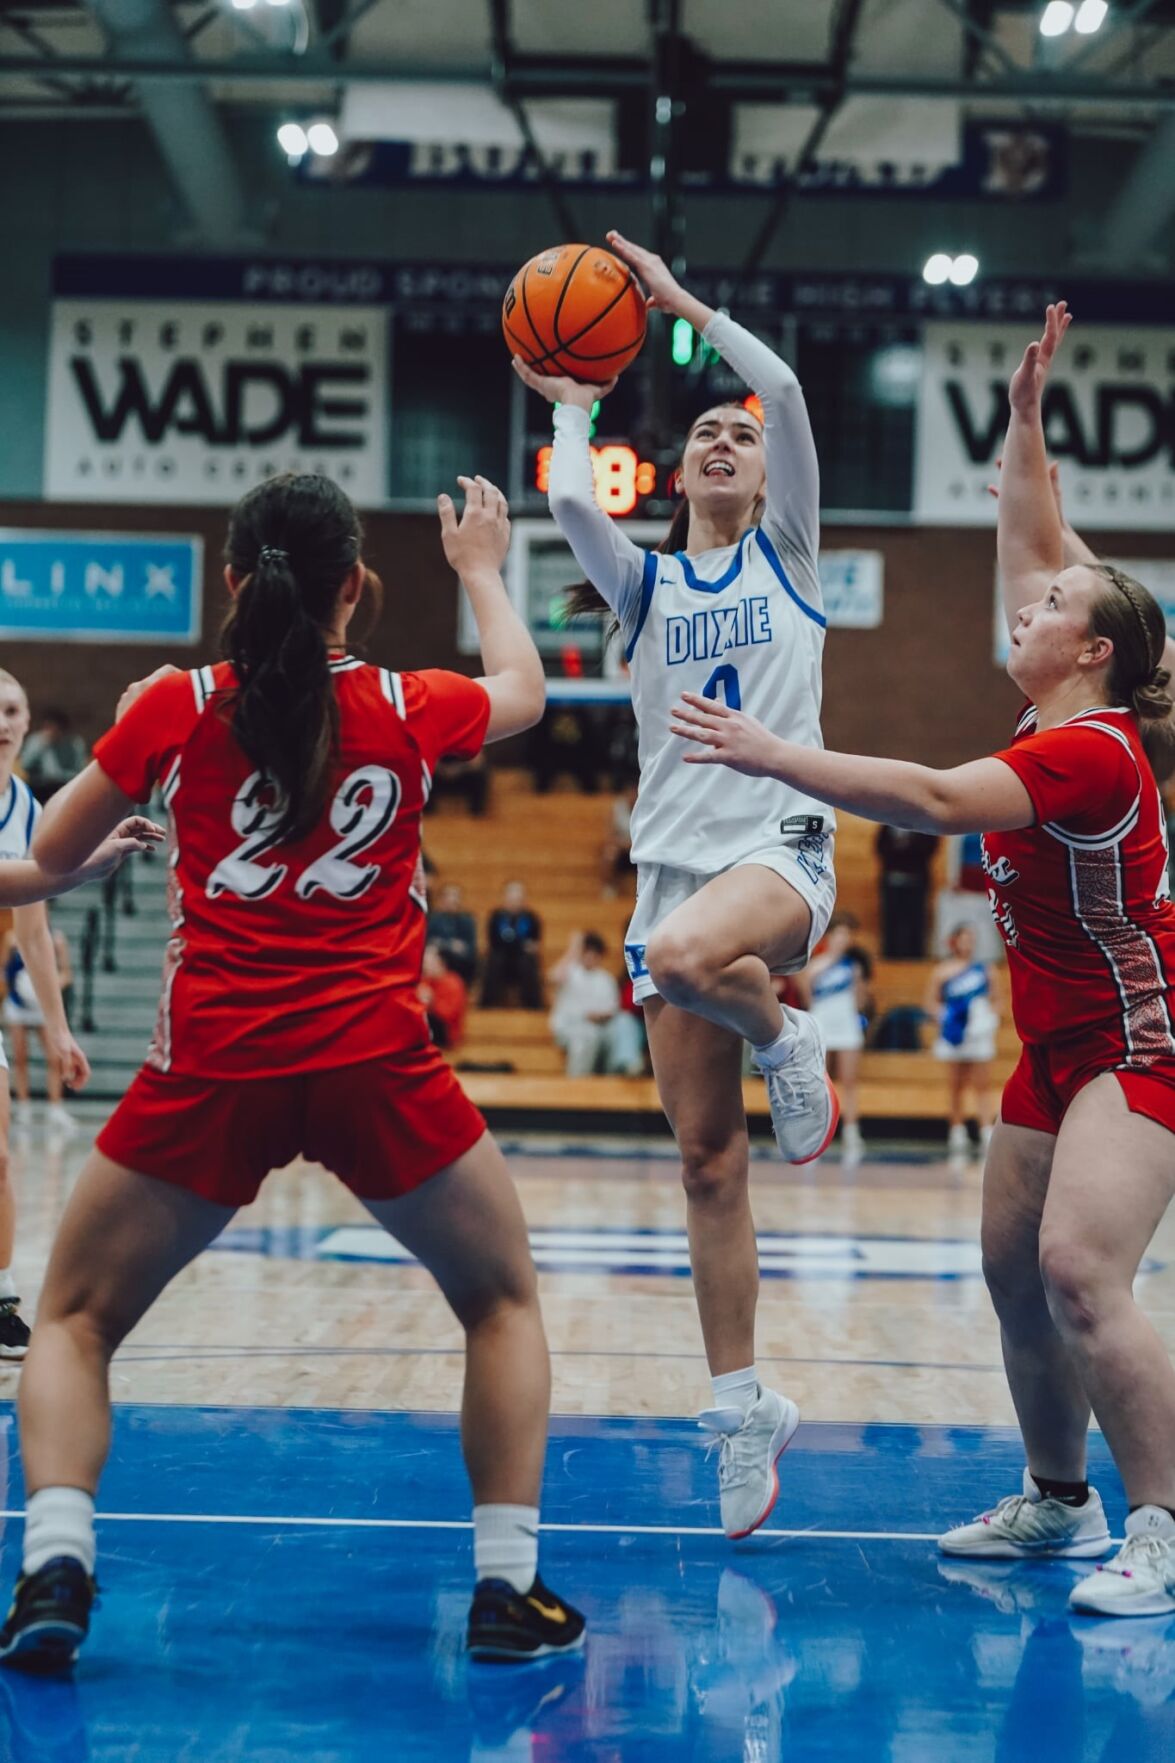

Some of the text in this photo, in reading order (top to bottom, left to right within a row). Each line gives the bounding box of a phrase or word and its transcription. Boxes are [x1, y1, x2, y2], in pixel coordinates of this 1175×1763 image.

[74, 317, 367, 351] STEPHEN
[69, 355, 369, 447] WADE
[944, 376, 1175, 471] WAD
[2, 557, 178, 602] LINX
[667, 596, 772, 666] DIXIE
[205, 764, 402, 901] 22
